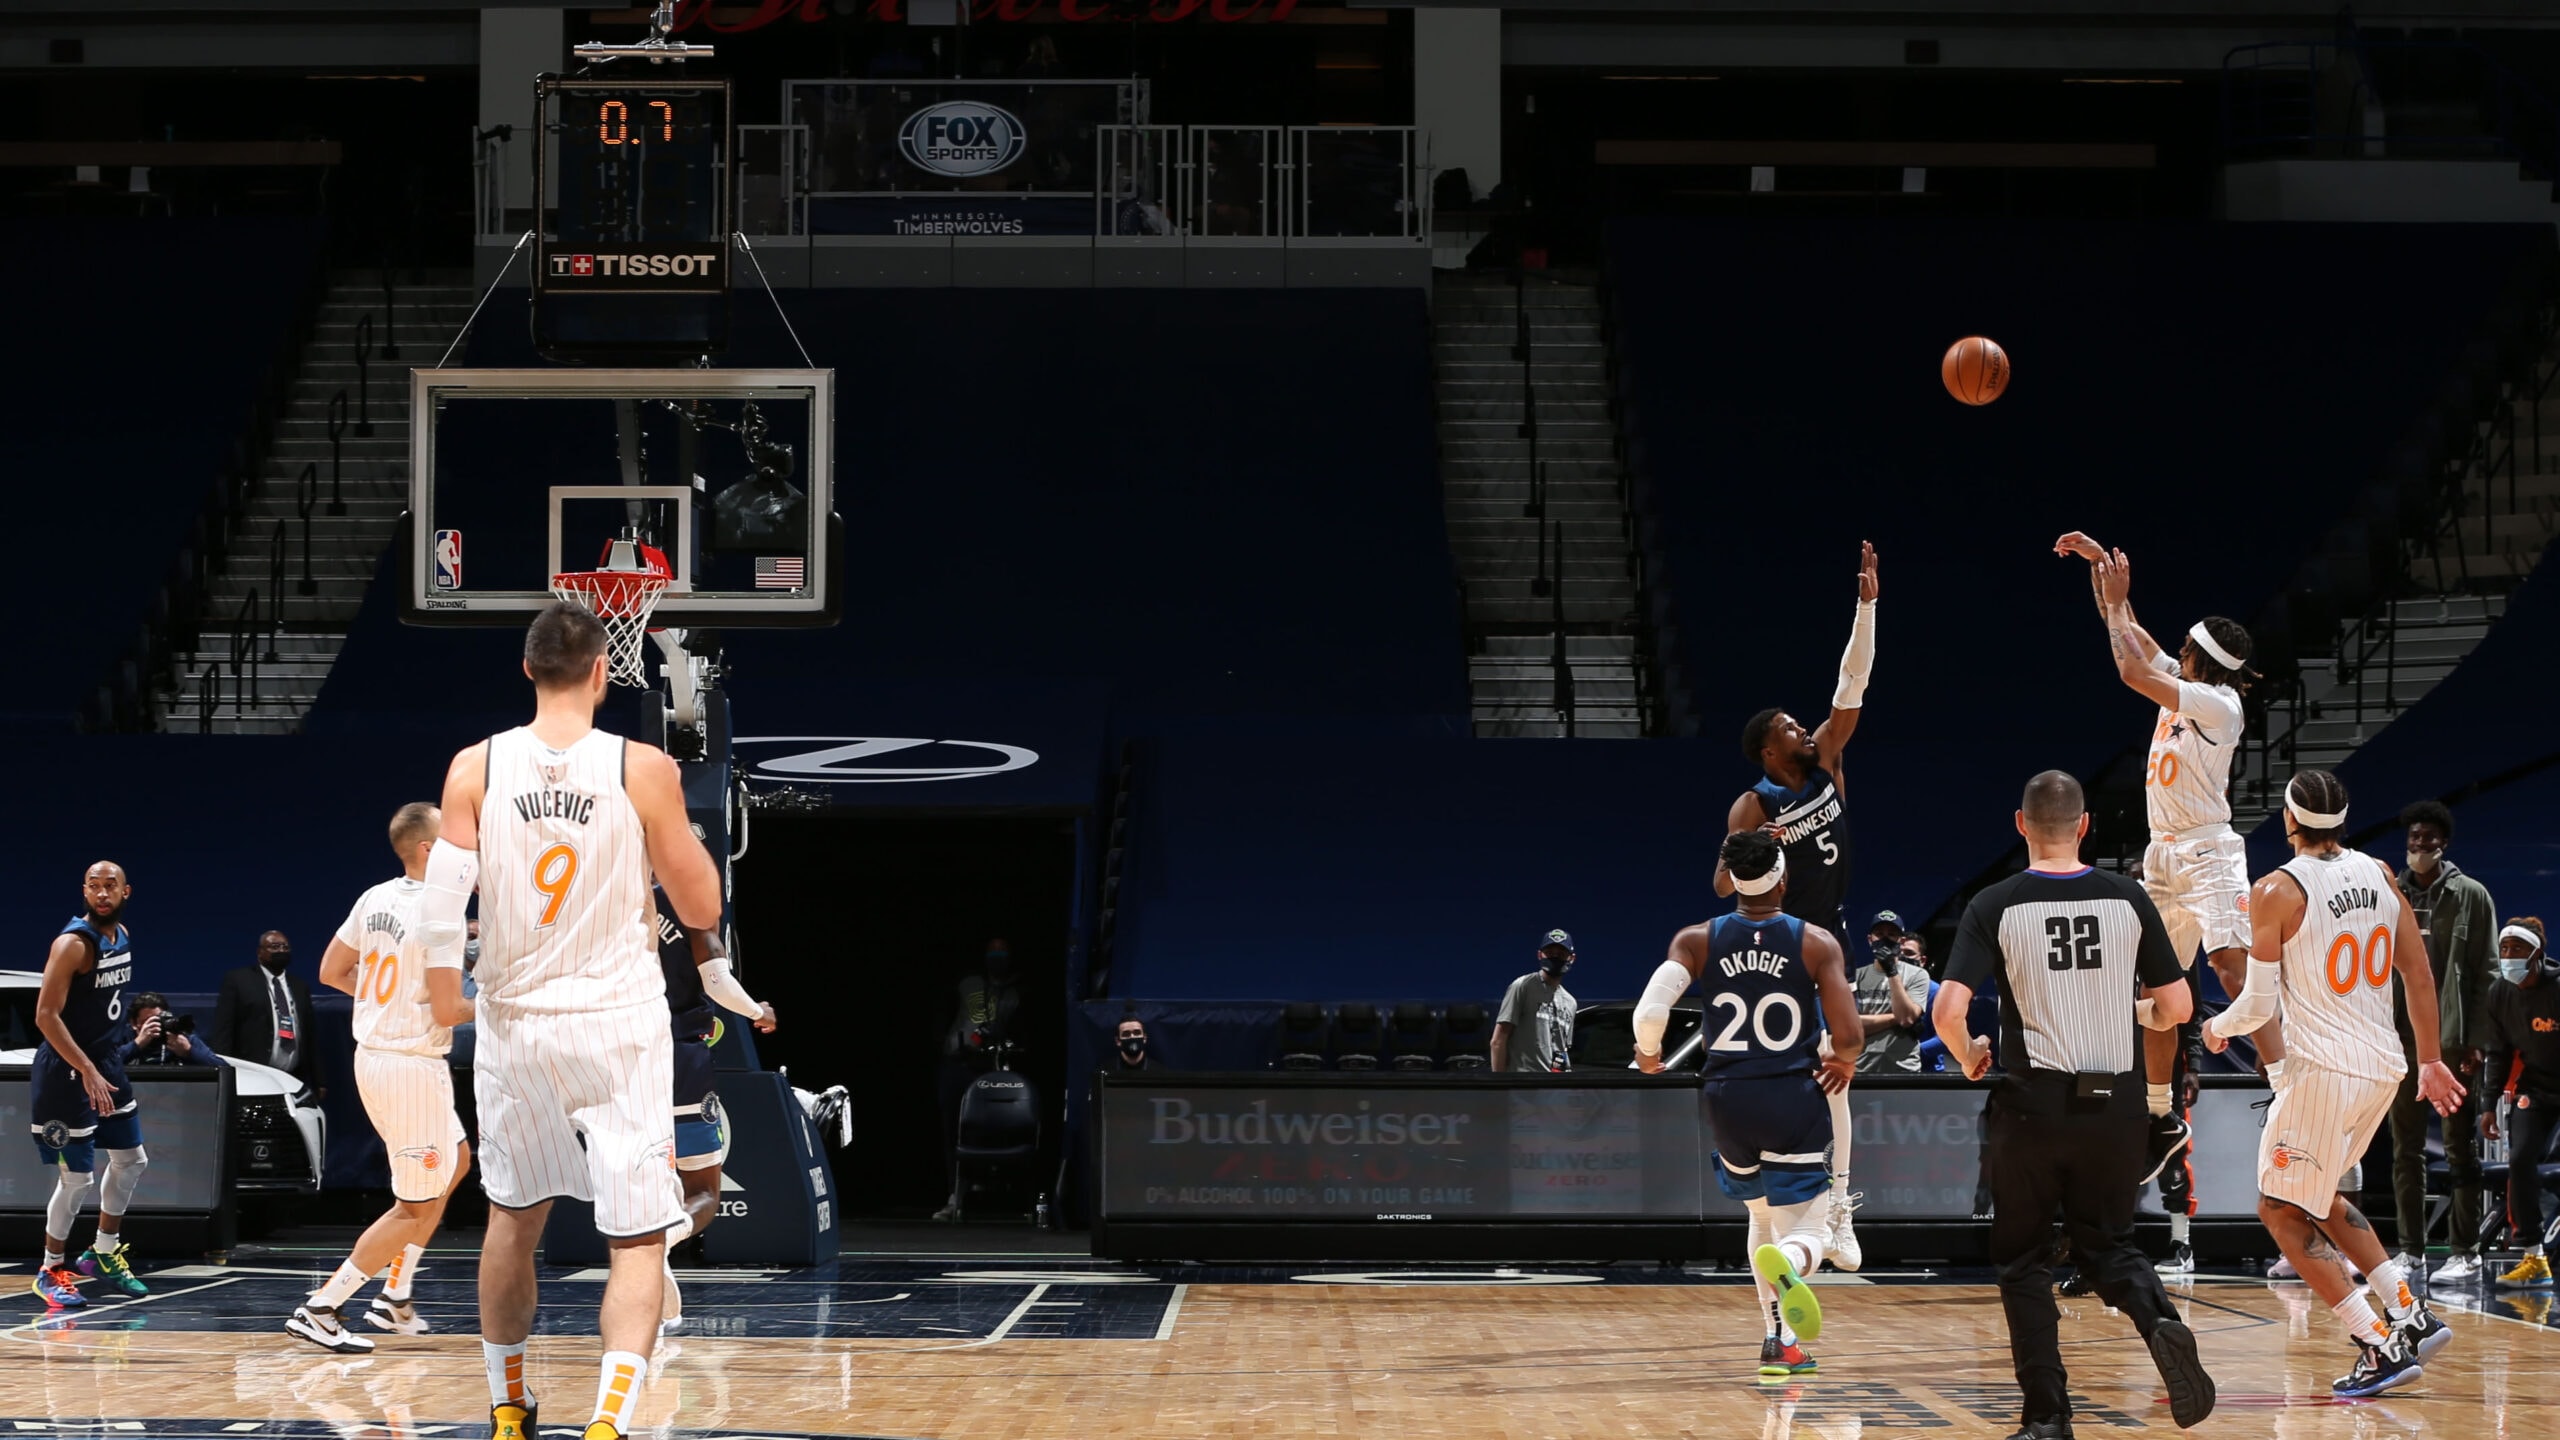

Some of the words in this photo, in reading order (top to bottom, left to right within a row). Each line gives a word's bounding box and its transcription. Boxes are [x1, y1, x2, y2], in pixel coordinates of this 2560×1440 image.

[600, 101, 672, 144] 0.7
[927, 116, 998, 147] FOX
[926, 148, 998, 160] SPORTS
[893, 219, 1023, 235] TIMBERWOLVES
[911, 212, 1005, 220] MINNESOTA
[596, 254, 716, 276] TISSOT
[426, 599, 468, 609] SPALDING
[1779, 798, 1842, 846] MINNESOTA
[1815, 830, 1839, 866] 5
[531, 842, 580, 930] 9
[2327, 887, 2378, 919] GORDON
[366, 911, 406, 946] FOURNIER
[2045, 915, 2102, 971] 32
[1719, 949, 1790, 979] OKOGIE
[2324, 923, 2393, 997] 00
[357, 947, 399, 1007] 10
[107, 989, 122, 1021] 6
[1709, 991, 1802, 1052] 20
[1149, 1099, 1471, 1145] Budweiser
[1179, 1187, 1255, 1205] ALCOHOL
[1324, 1187, 1350, 1205] ON
[1360, 1187, 1413, 1205] YOUR
[1419, 1187, 1474, 1205] GAME
